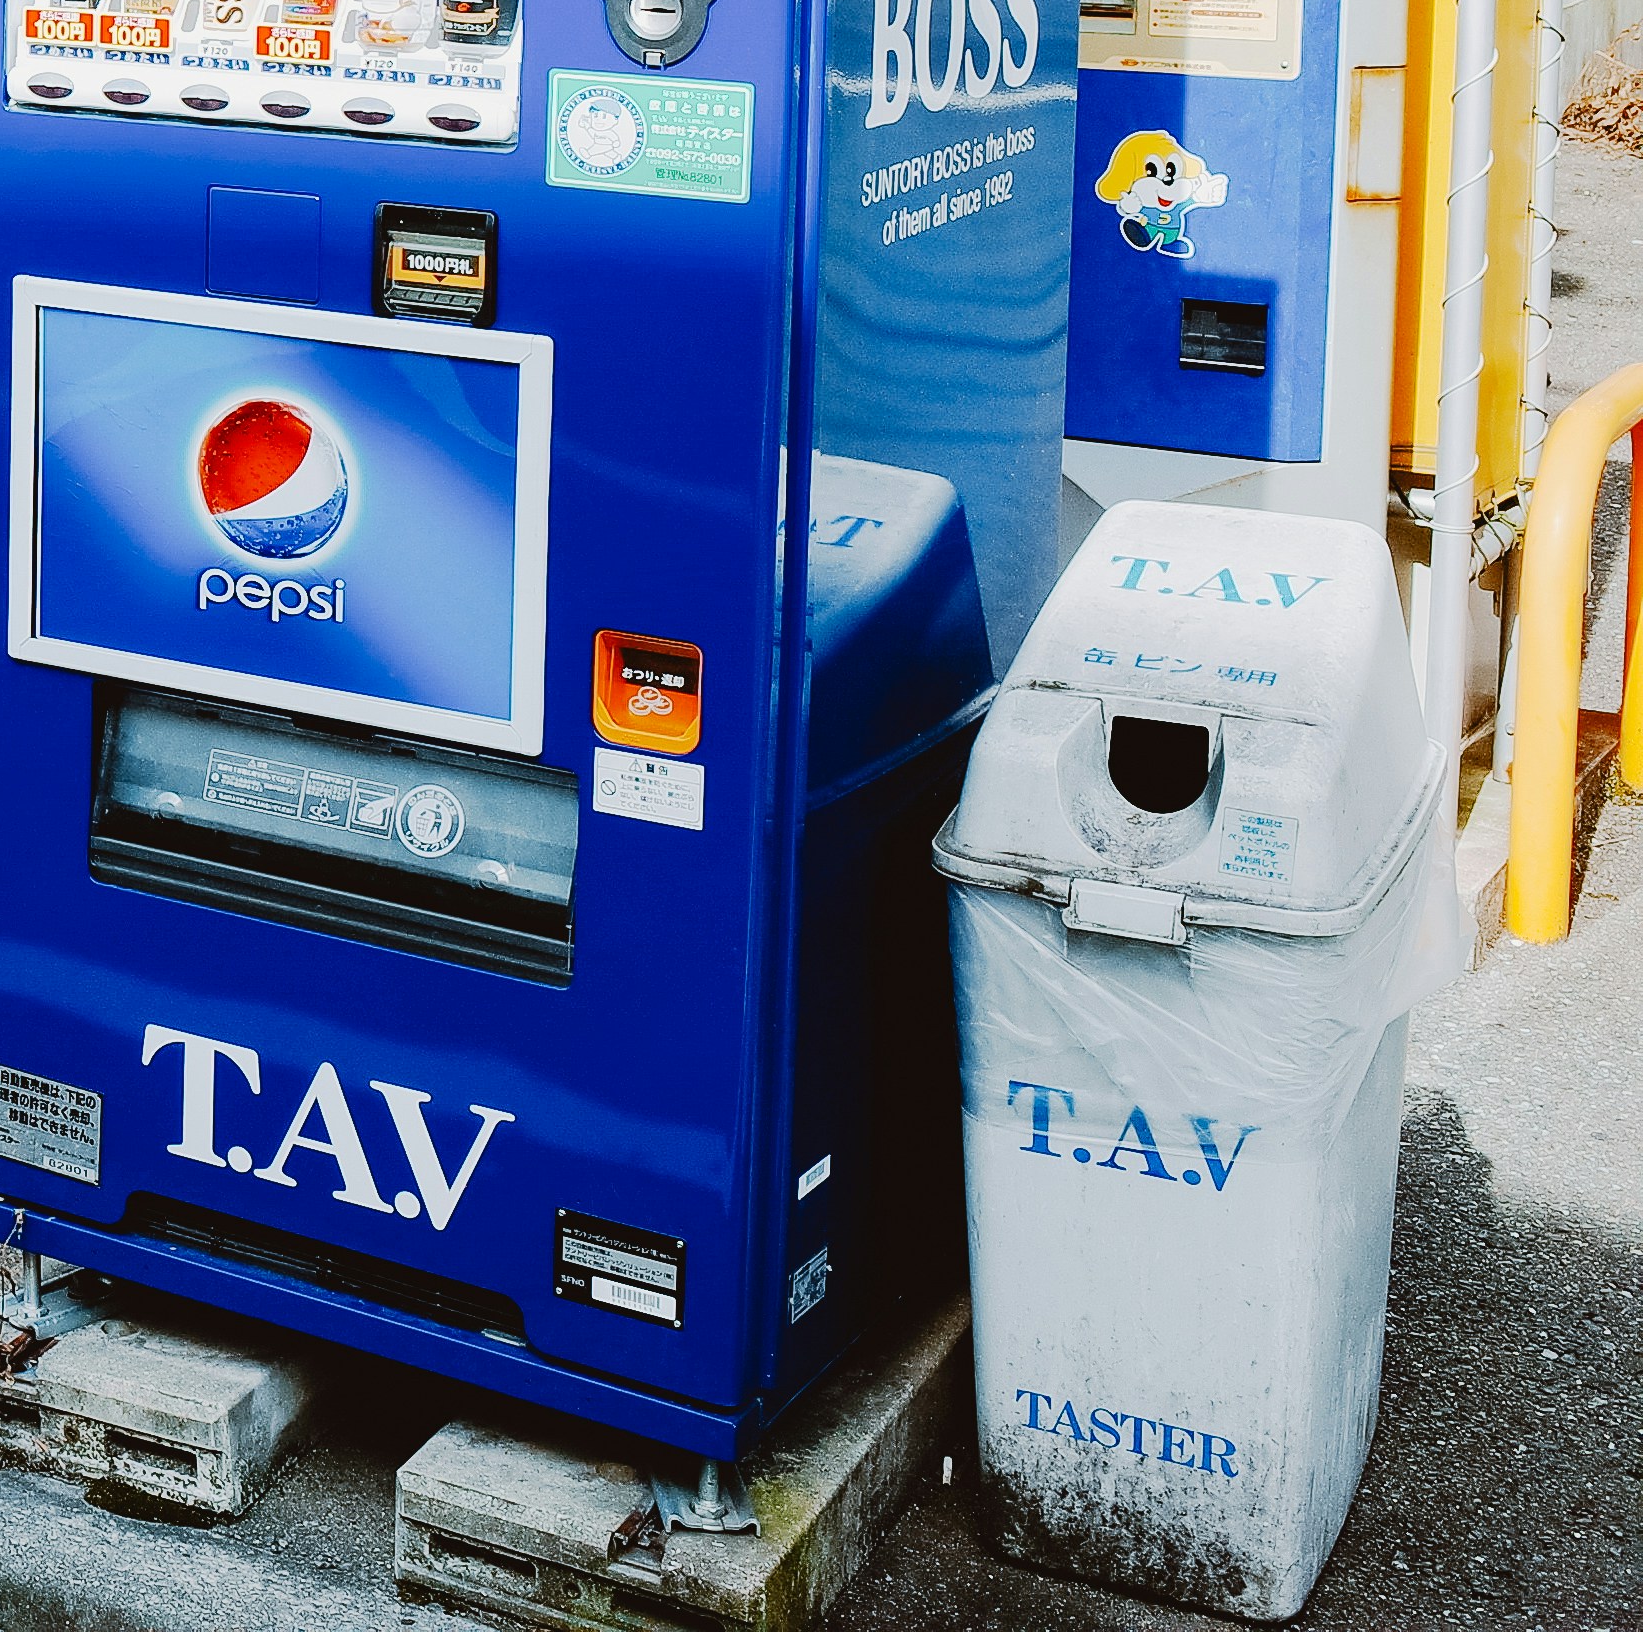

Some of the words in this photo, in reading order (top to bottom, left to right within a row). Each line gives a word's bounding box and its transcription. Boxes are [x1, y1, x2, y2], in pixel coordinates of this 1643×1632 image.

[35, 20, 85, 40] 100円
[109, 27, 161, 46] 100円
[266, 37, 321, 59] 100円
[861, 149, 932, 207] SUNTORY
[932, 139, 971, 182] BOSS
[973, 138, 983, 170] is
[985, 131, 1005, 166] the
[1006, 126, 1036, 160] boss
[882, 211, 898, 246] of
[897, 200, 931, 242] them
[932, 195, 948, 226] all
[949, 186, 982, 221] since
[983, 170, 1014, 208] 1992
[406, 253, 474, 276] 1000円札
[197, 566, 347, 625] pepsi
[1109, 553, 1334, 609] T.A.V
[1006, 1078, 1262, 1192] T.A.V
[1015, 1388, 1240, 1478] TASTER
